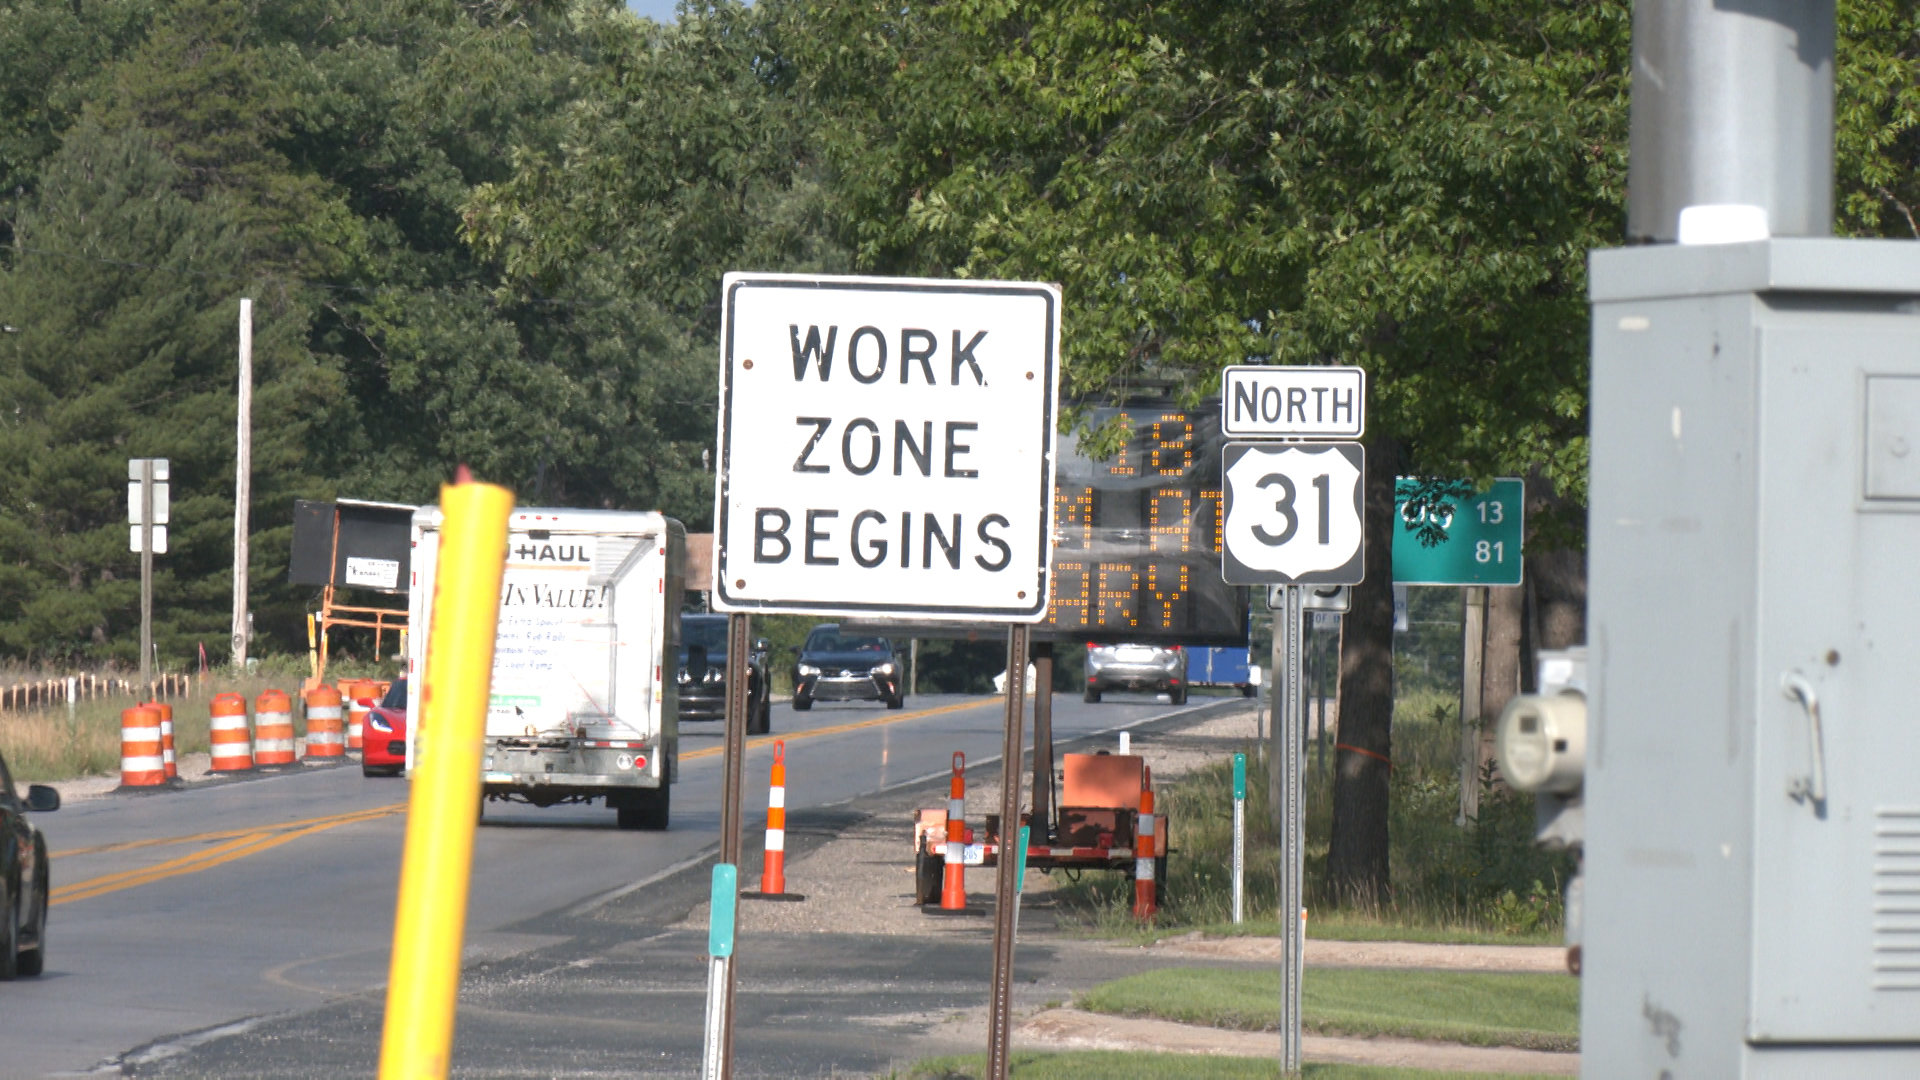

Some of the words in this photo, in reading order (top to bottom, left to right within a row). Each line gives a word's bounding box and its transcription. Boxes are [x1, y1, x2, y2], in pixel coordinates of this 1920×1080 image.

[789, 323, 989, 388] WORK
[1234, 380, 1353, 424] NORTH
[793, 416, 979, 479] ZONE
[1110, 412, 1193, 477] 18
[753, 506, 1012, 573] BEGINS
[1251, 472, 1330, 548] 31
[1476, 500, 1504, 524] 13
[1475, 540, 1504, 563] 81
